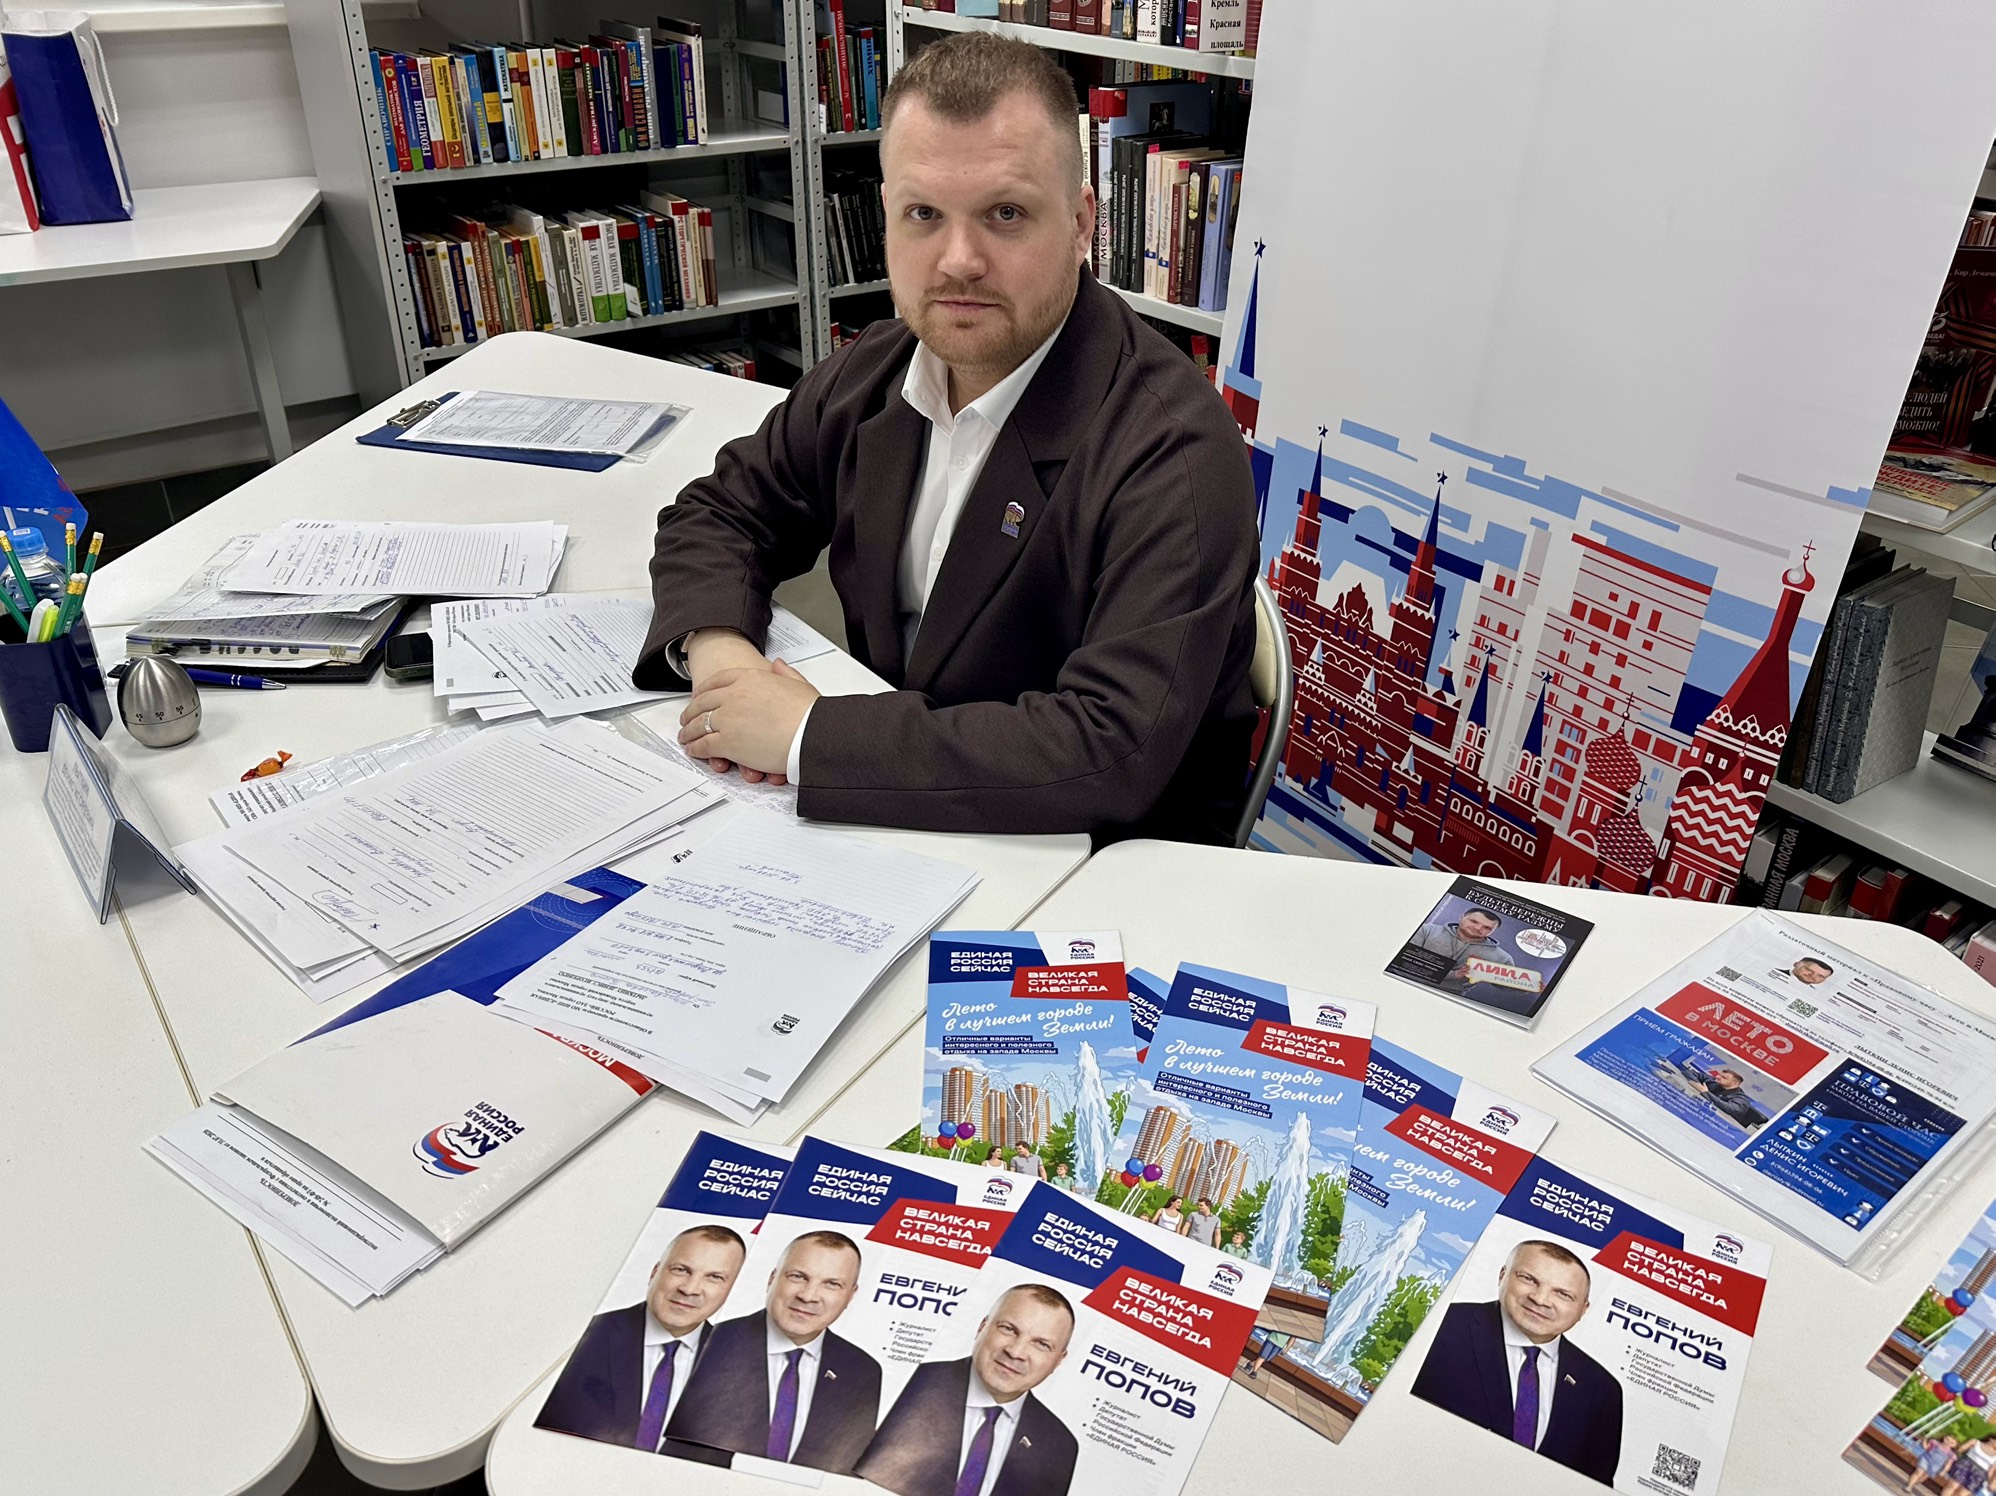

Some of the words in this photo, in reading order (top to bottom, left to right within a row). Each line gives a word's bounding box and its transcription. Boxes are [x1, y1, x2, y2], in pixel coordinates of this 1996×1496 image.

[1211, 0, 1239, 10] Кремль
[1209, 19, 1241, 29] Красная
[1210, 39, 1243, 49] площадь
[498, 55, 509, 93] МАТЕМАТИКА
[376, 87, 391, 146] СПРАВОЧНИК
[414, 100, 431, 156] ГЕОМЕТРИЯ
[588, 99, 600, 145] Дискретная
[605, 223, 616, 249] ВЫСШАЯ
[679, 226, 688, 269] ТЕОРЕТИЧЕСКОЙ
[593, 253, 603, 293] МАТЕМАТИКА
[608, 251, 620, 292] МАТЕМАТИКА
[683, 269, 691, 300] МЕХАНИКИ
[1911, 391, 1948, 404] ЛЮДЕЙ
[1776, 827, 1799, 868] МОСКВА
[1468, 890, 1510, 910] БУДЬТЕ
[1511, 905, 1564, 929] БЕРЕЖНЫ
[1474, 897, 1517, 917] СВОЕМУ
[1518, 914, 1561, 932] РАЗУМУ
[733, 923, 776, 940] ОБРАЩЕНИЕ
[558, 970, 592, 984] ИГОРЕВИЧУ
[1778, 930, 1826, 957] Раздаточный
[1827, 955, 1863, 975] материал
[1945, 1012, 1964, 1027] Лето
[1975, 956, 1985, 970] 2021
[592, 981, 616, 991] ДЕНИСУ
[1193, 987, 1256, 1008] ЕДИНАЯ
[1494, 976, 1534, 989] РАЙОНА
[942, 1003, 997, 1018] Лето
[945, 1018, 954, 1031] в
[960, 1014, 1031, 1031] лучшем
[1038, 1003, 1092, 1024] городе
[1188, 1002, 1250, 1022] СЕЙЧАС
[1191, 995, 1254, 1015] РОССИЯ
[1042, 1015, 1114, 1038] Земли!
[1265, 1026, 1340, 1049] ВЕЛИКАЯ
[1316, 1021, 1342, 1029] РОССИЯ
[1633, 1014, 1665, 1037] ПРИЁМ
[1684, 1012, 1697, 1023] В
[1698, 1020, 1779, 1067] МОСКВЕ
[1698, 1002, 1795, 1055] ЛЕТО
[597, 1035, 644, 1060] ДОВЕРЕННОСТЬ
[1165, 1039, 1224, 1058] Лето
[1261, 1042, 1346, 1067] НАВСЕГДА
[1264, 1034, 1327, 1054] СТРАНА
[1160, 1072, 1204, 1087] Отличные
[1206, 1082, 1248, 1098] варианты
[1164, 1056, 1175, 1068] в
[1180, 1060, 1256, 1079] лучшем
[1261, 1070, 1323, 1086] городе
[1854, 1043, 1890, 1065] ЛЫТКИН
[1889, 1063, 1917, 1080] ДЕНИС
[1916, 1076, 1959, 1101] ИГОРЕВИЧ
[1155, 1086, 1187, 1098] отдыха
[1200, 1096, 1232, 1108] западе
[1233, 1103, 1270, 1118] Москвы
[1158, 1079, 1212, 1098] интересного
[1222, 1093, 1268, 1110] полезного
[1262, 1084, 1343, 1106] Земли!
[1834, 1079, 1909, 1123] ПРАВОВОЙ
[1911, 1120, 1941, 1140] ЧАС
[464, 1108, 514, 1144] ЕДИНАЯ
[474, 1100, 525, 1136] РОССИЯ
[1413, 1122, 1478, 1157] СТРАНА
[1419, 1114, 1497, 1155] ВЕЛИКАЯ
[1406, 1129, 1493, 1174] НАВСЕГДА
[1766, 1138, 1807, 1163] ЛЫТКИН
[704, 1169, 780, 1191] РОССИЯ
[709, 1159, 783, 1180] ЕДИНАЯ
[812, 1174, 889, 1196] РОССИЯ
[818, 1164, 892, 1185] ЕДИНАЯ
[1393, 1159, 1461, 1188] городе
[1759, 1143, 1798, 1166] ДЕНИС
[1799, 1162, 1849, 1197] ИГОРЕВИЧ
[259, 1177, 301, 1209] ДОВЕРЕННОСТЬ
[698, 1180, 771, 1201] СЕЙЧАС
[808, 1185, 881, 1206] СЕЙЧАС
[1349, 1184, 1386, 1207] Москвы
[1385, 1173, 1476, 1211] Земли!
[1533, 1187, 1611, 1224] РОССИЯ
[1537, 1179, 1614, 1215] ЕДИНАЯ
[899, 1219, 973, 1240] СТРАНА
[904, 1207, 990, 1231] ВЕЛИКАЯ
[1529, 1196, 1605, 1232] СЕЙЧАС
[895, 1230, 992, 1256] НАВСЕГДА
[1038, 1222, 1113, 1260] РОССИЯ
[1043, 1212, 1118, 1248] ЕДИНАЯ
[1031, 1233, 1104, 1269] СЕЙЧАС
[1629, 1241, 1723, 1284] ВЕЛИКАЯ
[1623, 1261, 1728, 1310] НАВСЕГДА
[1626, 1251, 1705, 1289] СТРАНА
[1119, 1289, 1193, 1327] СТРАНА
[1124, 1277, 1213, 1320] ВЕЛИКАЯ
[1113, 1301, 1212, 1349] НАВСЕГДА
[1611, 1297, 1723, 1350] ЕВГЕНИЙ
[1606, 1310, 1727, 1371] ПОПОВ
[1090, 1344, 1197, 1396] ЕВГЕНИЙ
[1633, 1354, 1662, 1368] Депутат
[1636, 1348, 1675, 1368] Журналист
[1080, 1359, 1196, 1419] ПОПОВ
[1626, 1376, 1662, 1394] «ЕДИНАЯ
[1663, 1390, 1700, 1410] РОССИЯ»
[1629, 1369, 1647, 1381] Член
[1647, 1378, 1678, 1394] фракции
[1630, 1364, 1673, 1387] Российской
[1674, 1382, 1714, 1404] Федерации
[1632, 1359, 1693, 1389] Государственной
[1694, 1383, 1715, 1398] Думы
[1099, 1406, 1127, 1422] Депутат
[1103, 1400, 1141, 1419] Журналист
[1090, 1425, 1106, 1437] Член
[1107, 1432, 1137, 1449] фракции
[1093, 1419, 1133, 1440] Российской
[1134, 1435, 1172, 1457] Федерации
[1096, 1412, 1154, 1441] Государственной
[1154, 1436, 1175, 1450] Думы
[1086, 1432, 1120, 1451] «ЕДИНАЯ
[1121, 1447, 1156, 1465] РОССИЯ»
